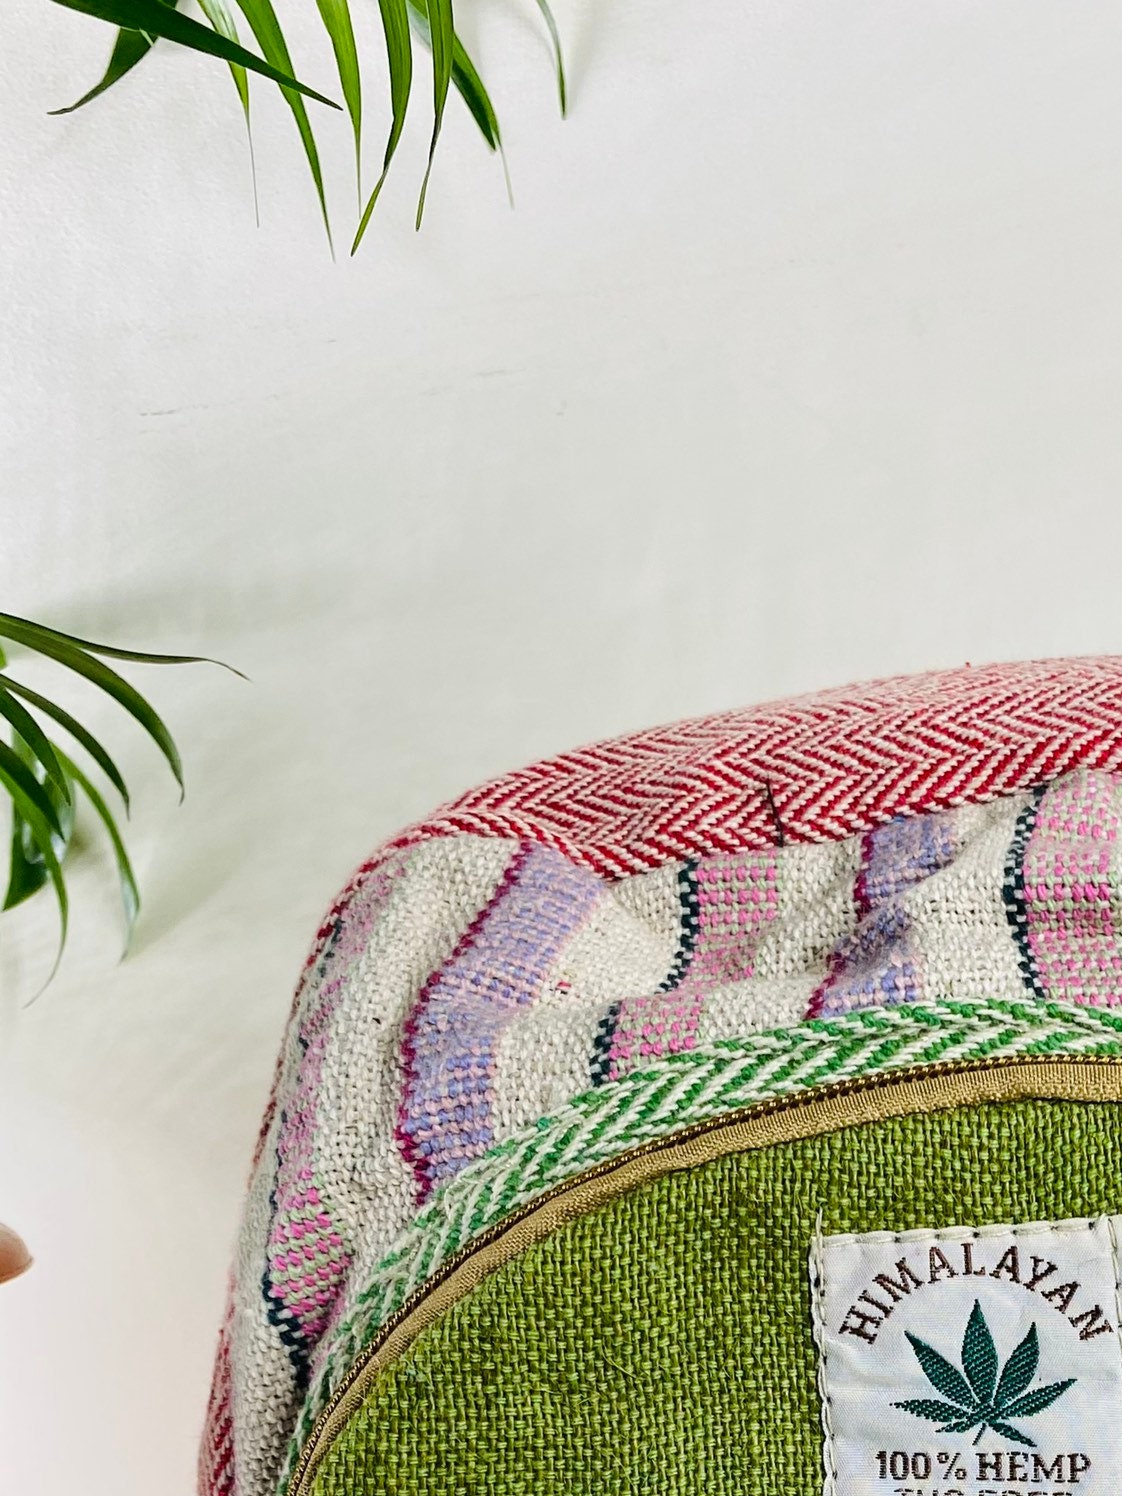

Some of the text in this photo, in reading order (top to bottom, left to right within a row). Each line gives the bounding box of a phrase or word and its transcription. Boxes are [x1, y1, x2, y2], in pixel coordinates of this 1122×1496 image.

[838, 1243, 1114, 1345] HIMALAYAN
[875, 1451, 1092, 1483] 100% HEMP
